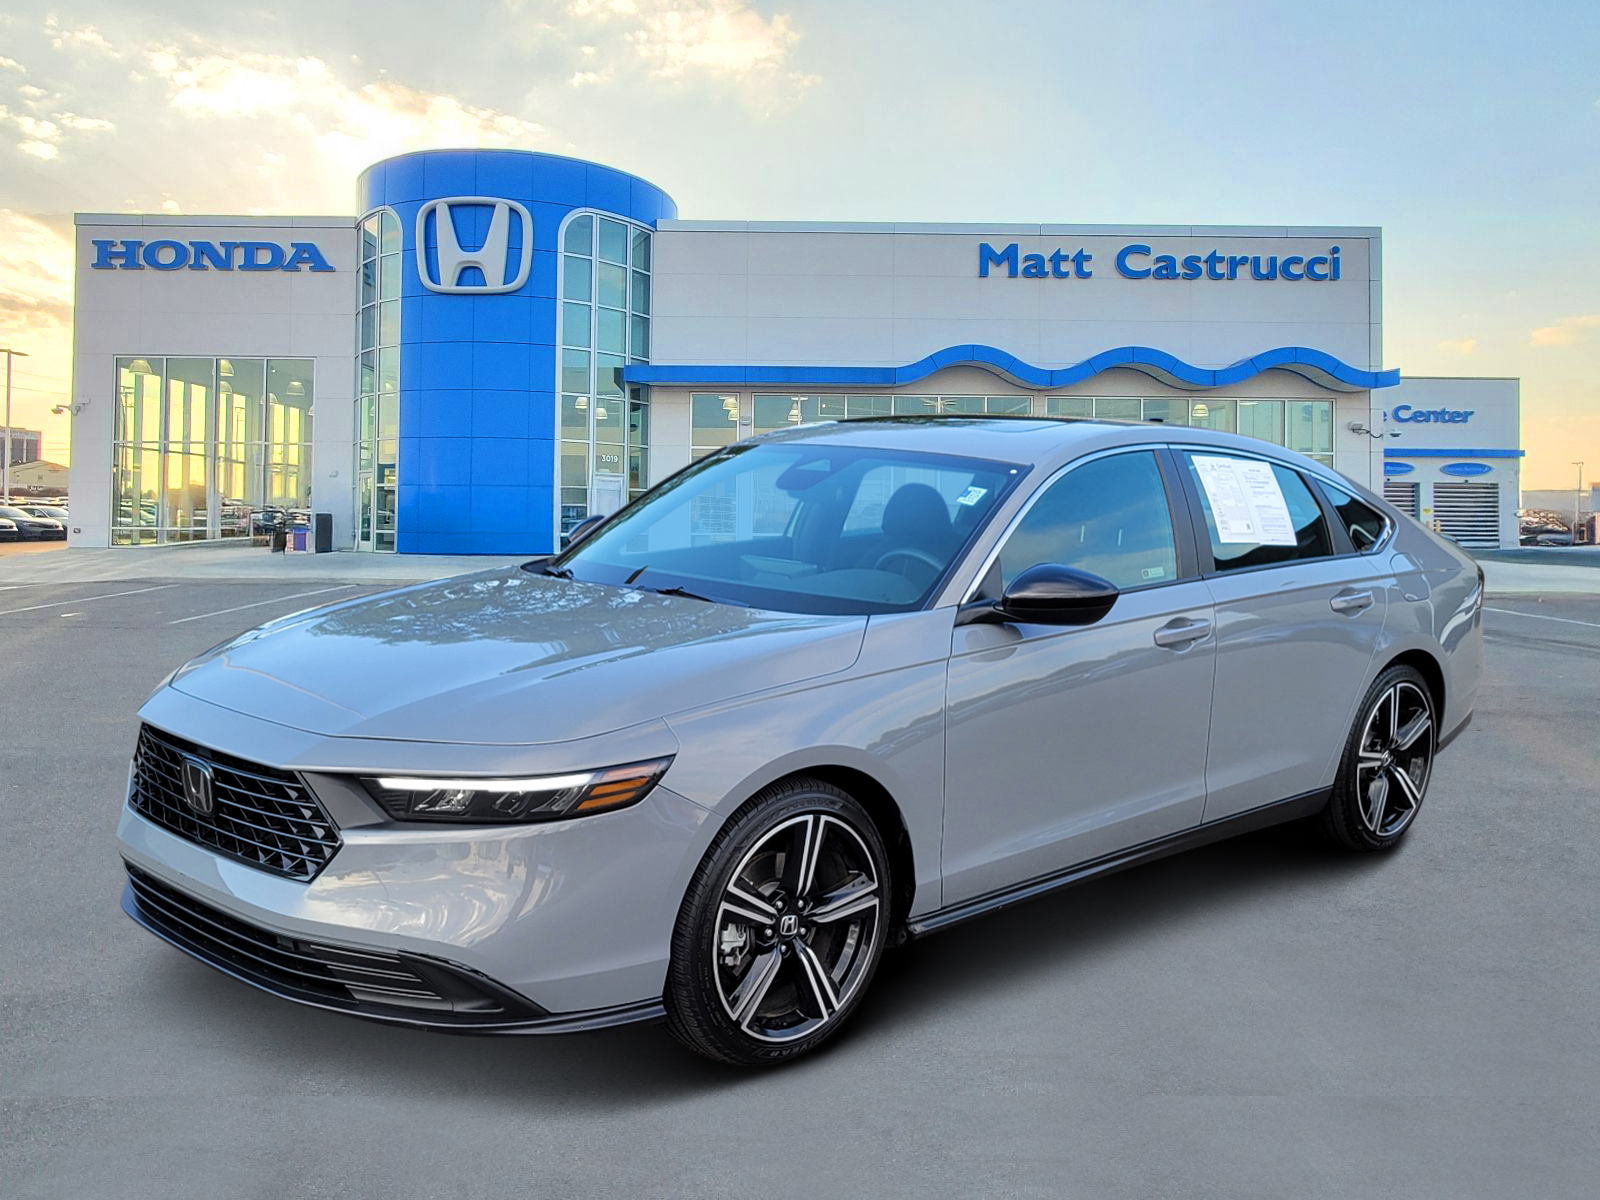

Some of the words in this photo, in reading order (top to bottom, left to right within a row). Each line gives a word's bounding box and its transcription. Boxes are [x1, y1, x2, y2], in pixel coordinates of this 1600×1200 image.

[91, 239, 336, 272] HONDA
[978, 242, 1093, 279] Matt
[1115, 244, 1342, 280] Castrucci
[1392, 405, 1475, 424] Center
[601, 454, 618, 463] 3019
